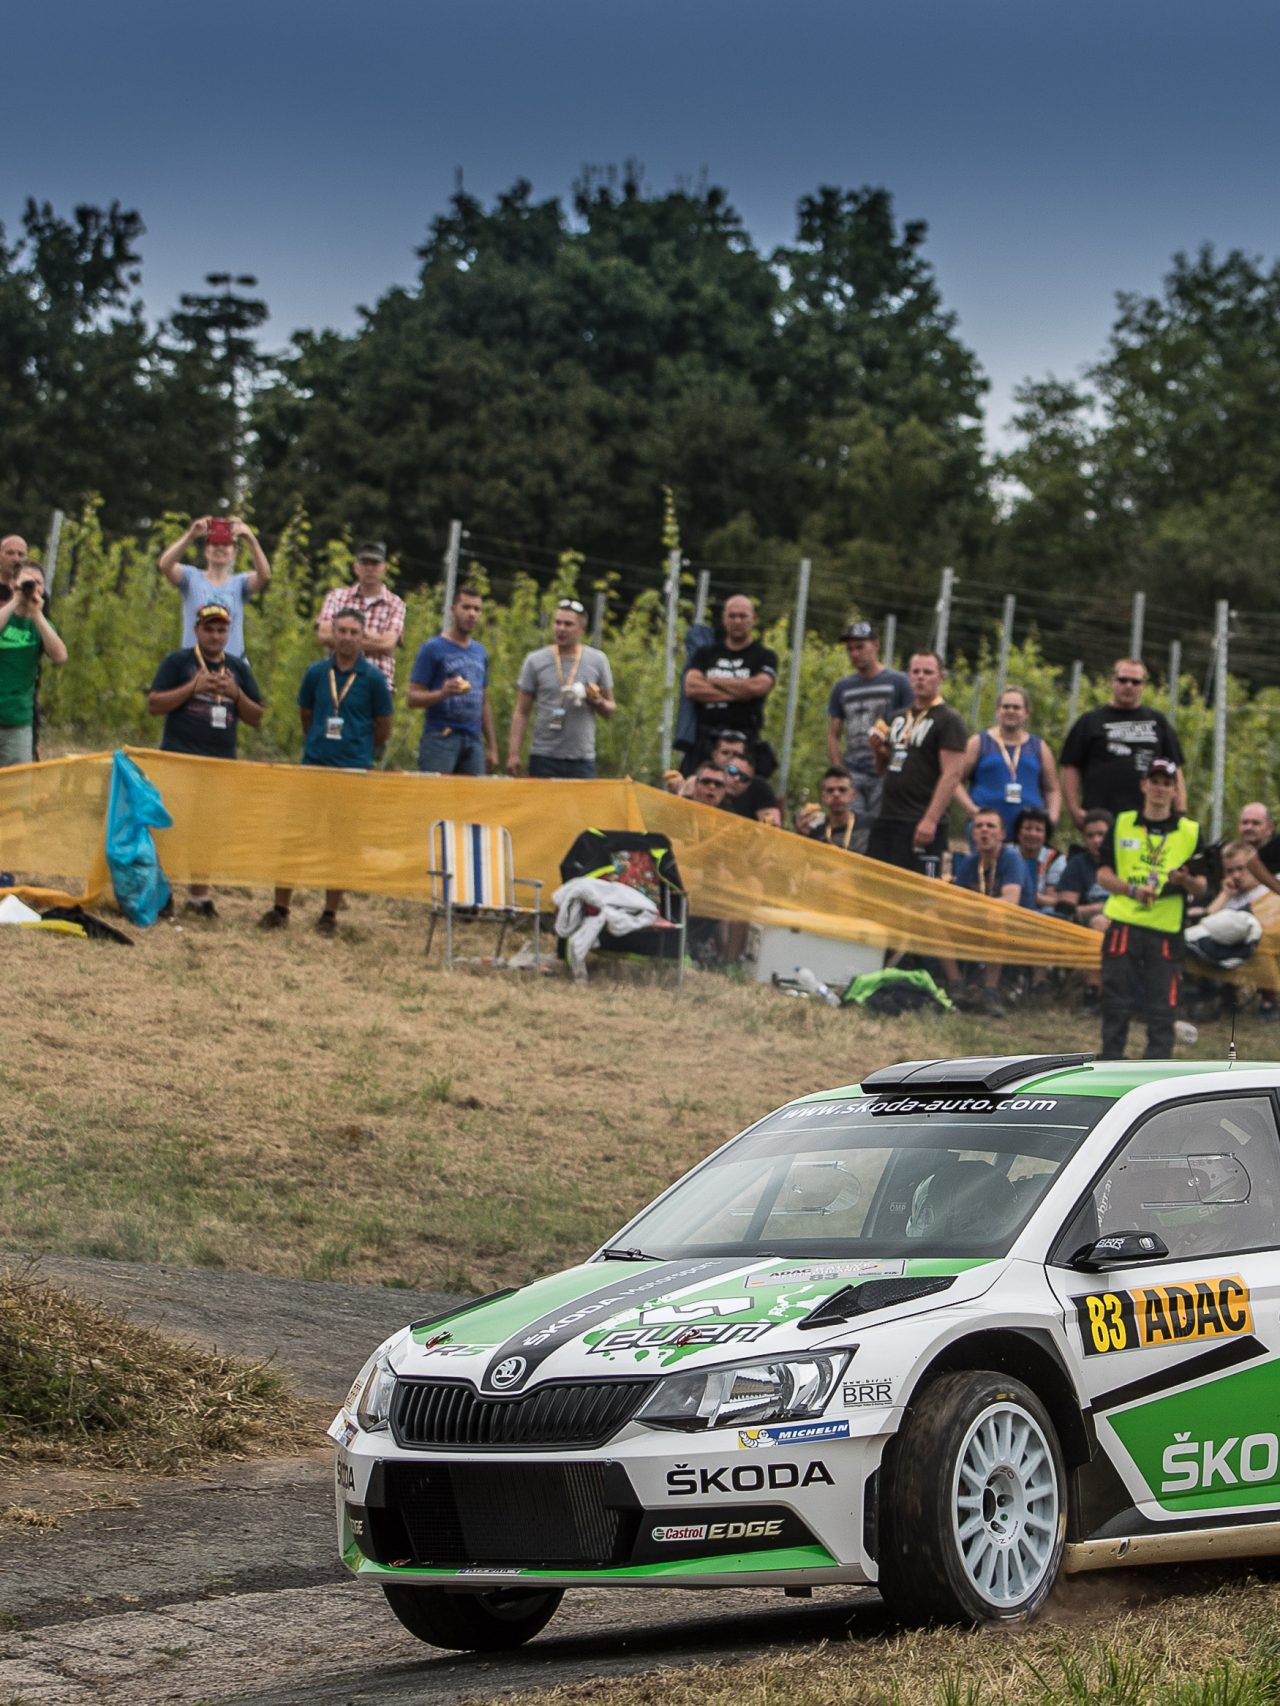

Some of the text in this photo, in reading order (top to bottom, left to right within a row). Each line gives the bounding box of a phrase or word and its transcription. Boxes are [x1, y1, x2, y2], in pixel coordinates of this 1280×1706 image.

[781, 1096, 1058, 1120] www.skoda-auto.com
[522, 1296, 625, 1346] ŠKODA
[1085, 1278, 1246, 1353] 83 ADAC
[843, 1384, 892, 1403] BRR
[778, 1424, 848, 1439] MICHELIN
[666, 1460, 835, 1496] ŠKODA
[665, 1519, 785, 1540] Castrol EDGE
